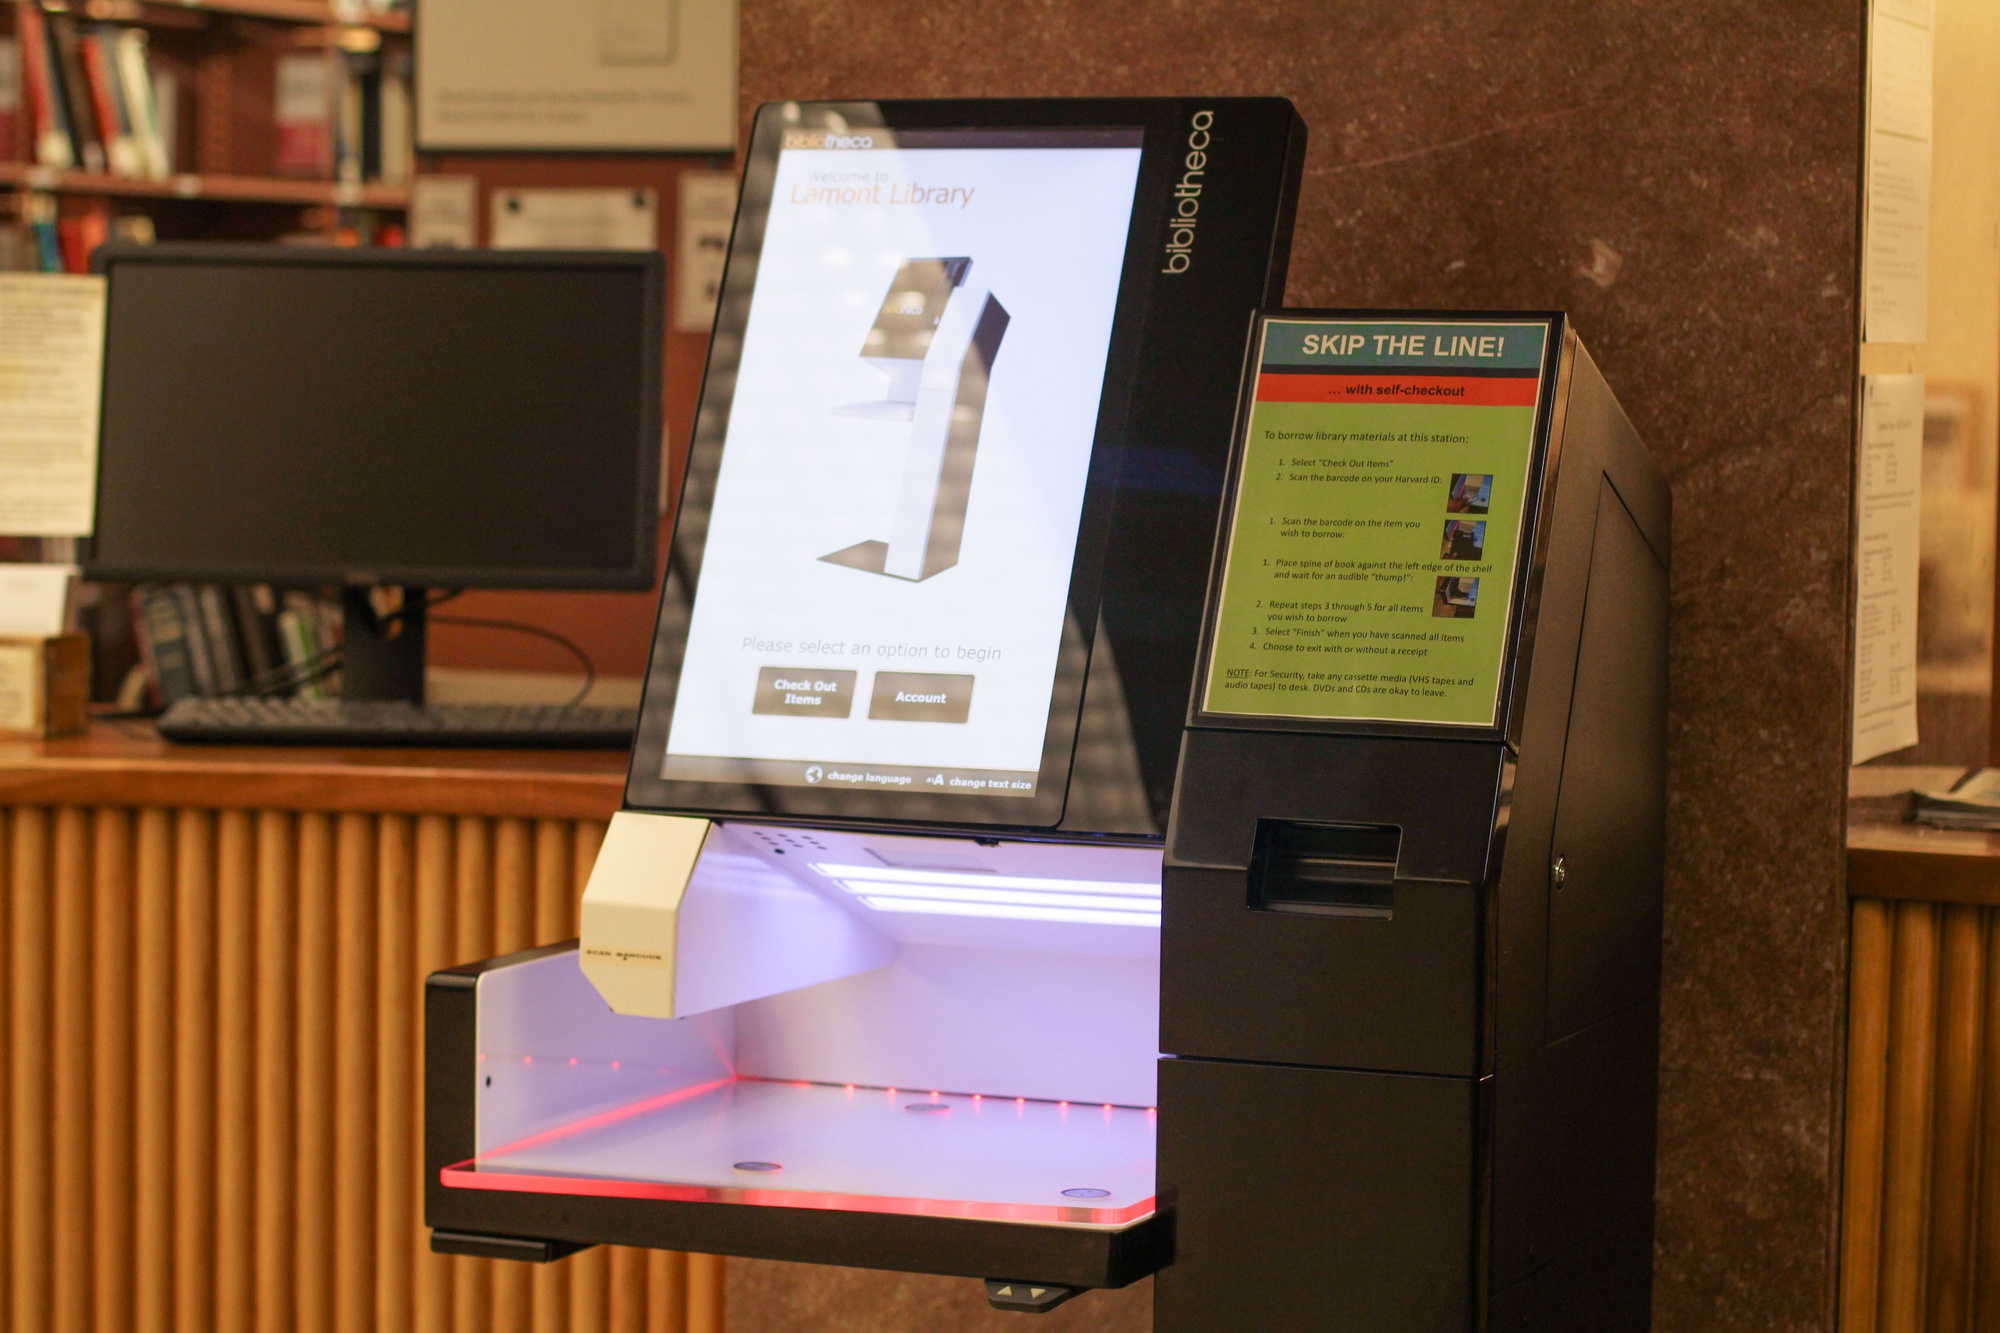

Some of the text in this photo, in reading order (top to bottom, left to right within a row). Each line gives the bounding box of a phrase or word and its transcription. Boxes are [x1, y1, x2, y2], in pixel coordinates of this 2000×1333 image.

[808, 171, 889, 183] Welcome to
[791, 183, 975, 209] Lamont Library
[1162, 111, 1214, 273] bibliotheca
[1303, 335, 1505, 357] SKIP THE LINE!
[1346, 384, 1372, 395] with
[1376, 385, 1465, 396] self-checkout
[1265, 431, 1468, 443] To borrow library materials at this station:
[1326, 474, 1359, 482] barcode
[1396, 475, 1428, 483] Harvard
[1431, 476, 1442, 484] ID:
[1320, 518, 1352, 526] barcode
[1281, 529, 1299, 538] wish
[1312, 530, 1345, 539] borrow:
[1276, 559, 1297, 567] Place
[1300, 561, 1322, 569] spine
[1324, 560, 1333, 568] of
[1335, 560, 1355, 568] book
[1358, 561, 1386, 571] against
[1389, 561, 1403, 569] the
[1405, 562, 1419, 570] left
[1422, 563, 1442, 572] edge
[1456, 564, 1469, 572] the
[1472, 564, 1492, 573] shelf
[1274, 571, 1289, 579] and
[1292, 571, 1309, 579] wait
[1312, 571, 1323, 580] for
[1338, 572, 1369, 581] audible
[1270, 601, 1298, 610] Repeat
[1301, 602, 1322, 610] steps
[1325, 602, 1329, 610] 3
[1332, 603, 1365, 612] through
[1374, 603, 1386, 611] for
[1388, 604, 1398, 612] all
[1400, 604, 1423, 613] items
[1267, 613, 1347, 623] you wish to borrow
[1252, 627, 1259, 635] 3.
[1265, 627, 1290, 636] Select
[1327, 629, 1350, 637] when
[1352, 631, 1367, 639] you
[1392, 631, 1427, 640] scanned
[1429, 632, 1439, 641] all
[1441, 633, 1465, 642] items
[742, 638, 1001, 662] Please select an option to begin
[1263, 643, 1293, 651] Choose
[1296, 644, 1304, 652] to
[1307, 644, 1322, 652] exit
[1324, 644, 1343, 653] with
[1356, 645, 1388, 654] without
[1398, 647, 1427, 657] receipt
[1226, 668, 1474, 686] NOTE: For Security, take any cassette media (VHS tapes and
[774, 679, 837, 692] Check Out
[1225, 681, 1248, 689] audio
[1250, 681, 1276, 691] tapes)
[1289, 683, 1310, 692] desk.
[1313, 684, 1335, 692] DVDs
[1337, 684, 1353, 693] and
[1356, 685, 1371, 693] CDs
[1389, 686, 1409, 696] okay
[1422, 687, 1447, 697] leave.
[784, 694, 822, 706] Items
[896, 692, 946, 704] Account
[828, 772, 912, 785] change language
[950, 777, 1032, 790] change text size
[616, 952, 661, 960] BARCODE
